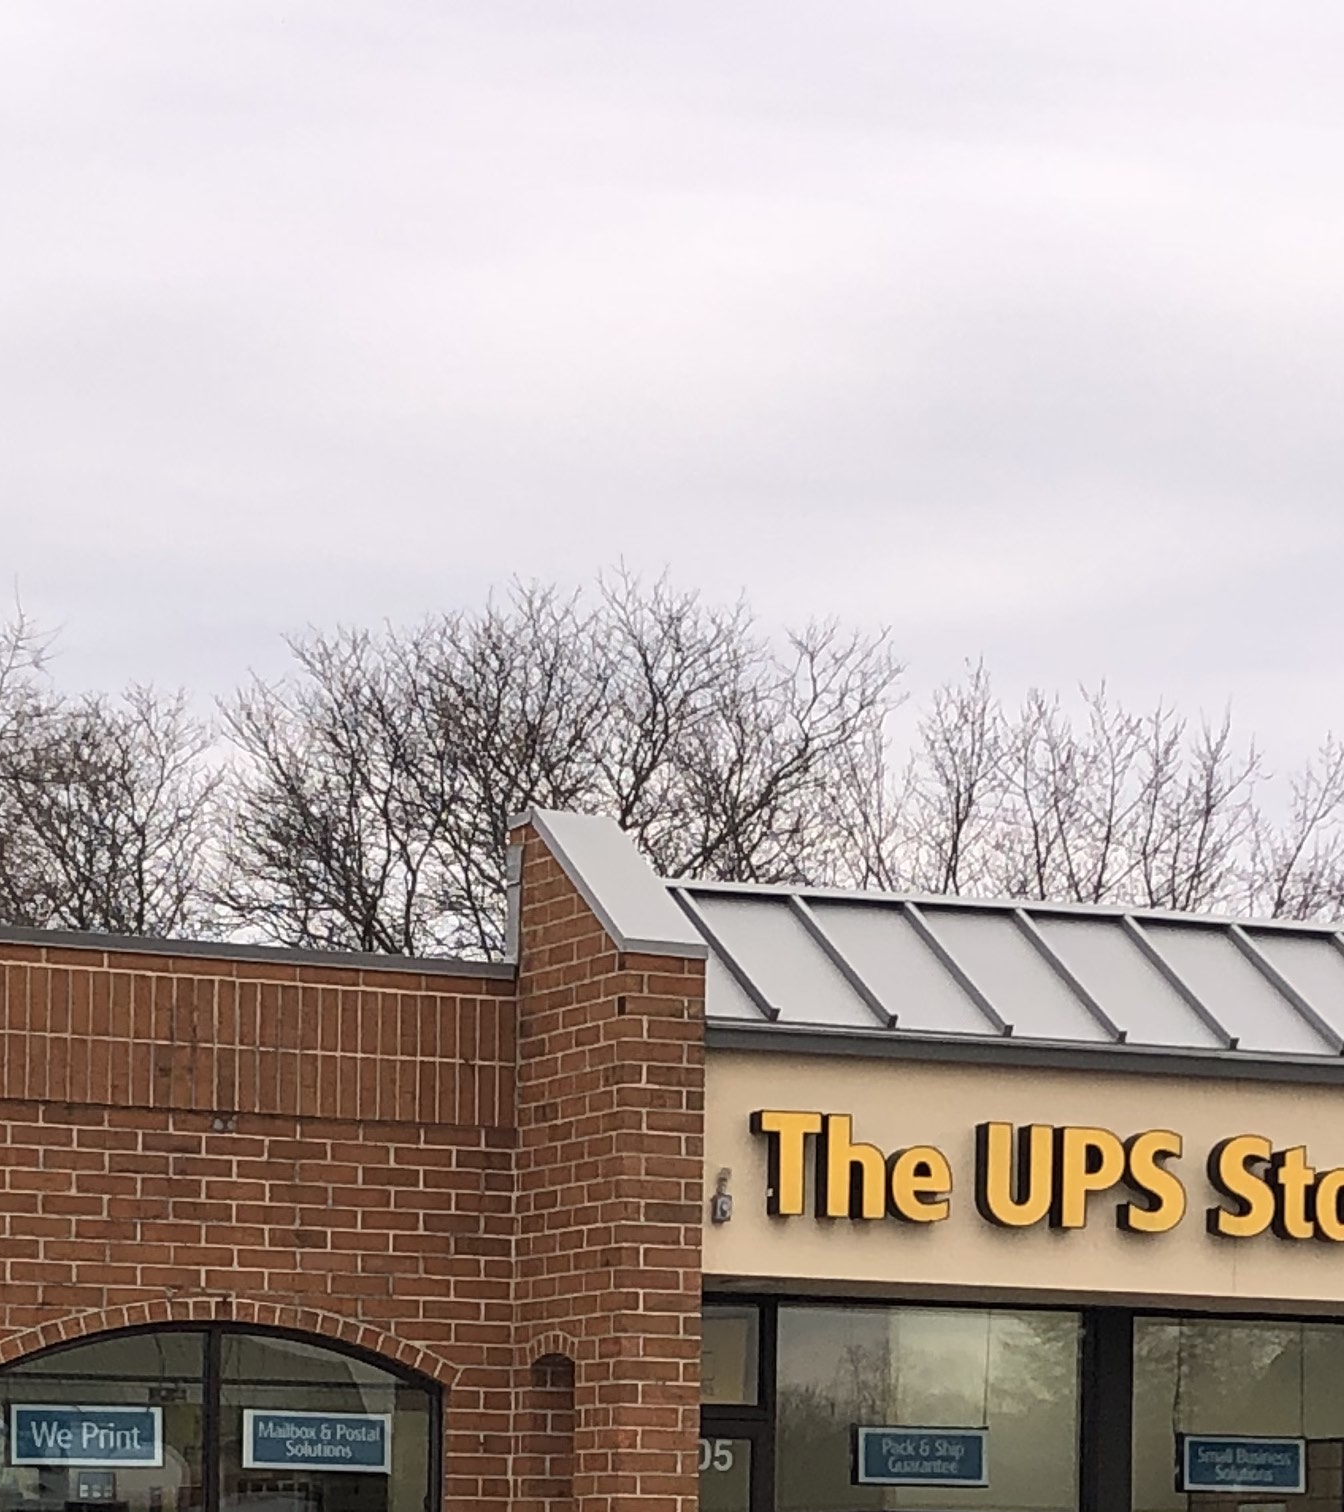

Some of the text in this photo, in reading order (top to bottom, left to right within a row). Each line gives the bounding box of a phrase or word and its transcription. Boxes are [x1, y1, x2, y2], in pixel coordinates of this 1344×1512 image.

[751, 1109, 953, 1222] The
[975, 1121, 1186, 1233] UPS
[30, 1421, 141, 1450] We Print
[258, 1421, 380, 1442] Mailbox & Postal
[285, 1440, 352, 1459] Solutions
[882, 1438, 965, 1460] Pack & Ship
[1197, 1446, 1292, 1466] Small Business
[888, 1456, 960, 1474] Guarantee
[1215, 1464, 1274, 1482] Solutions
